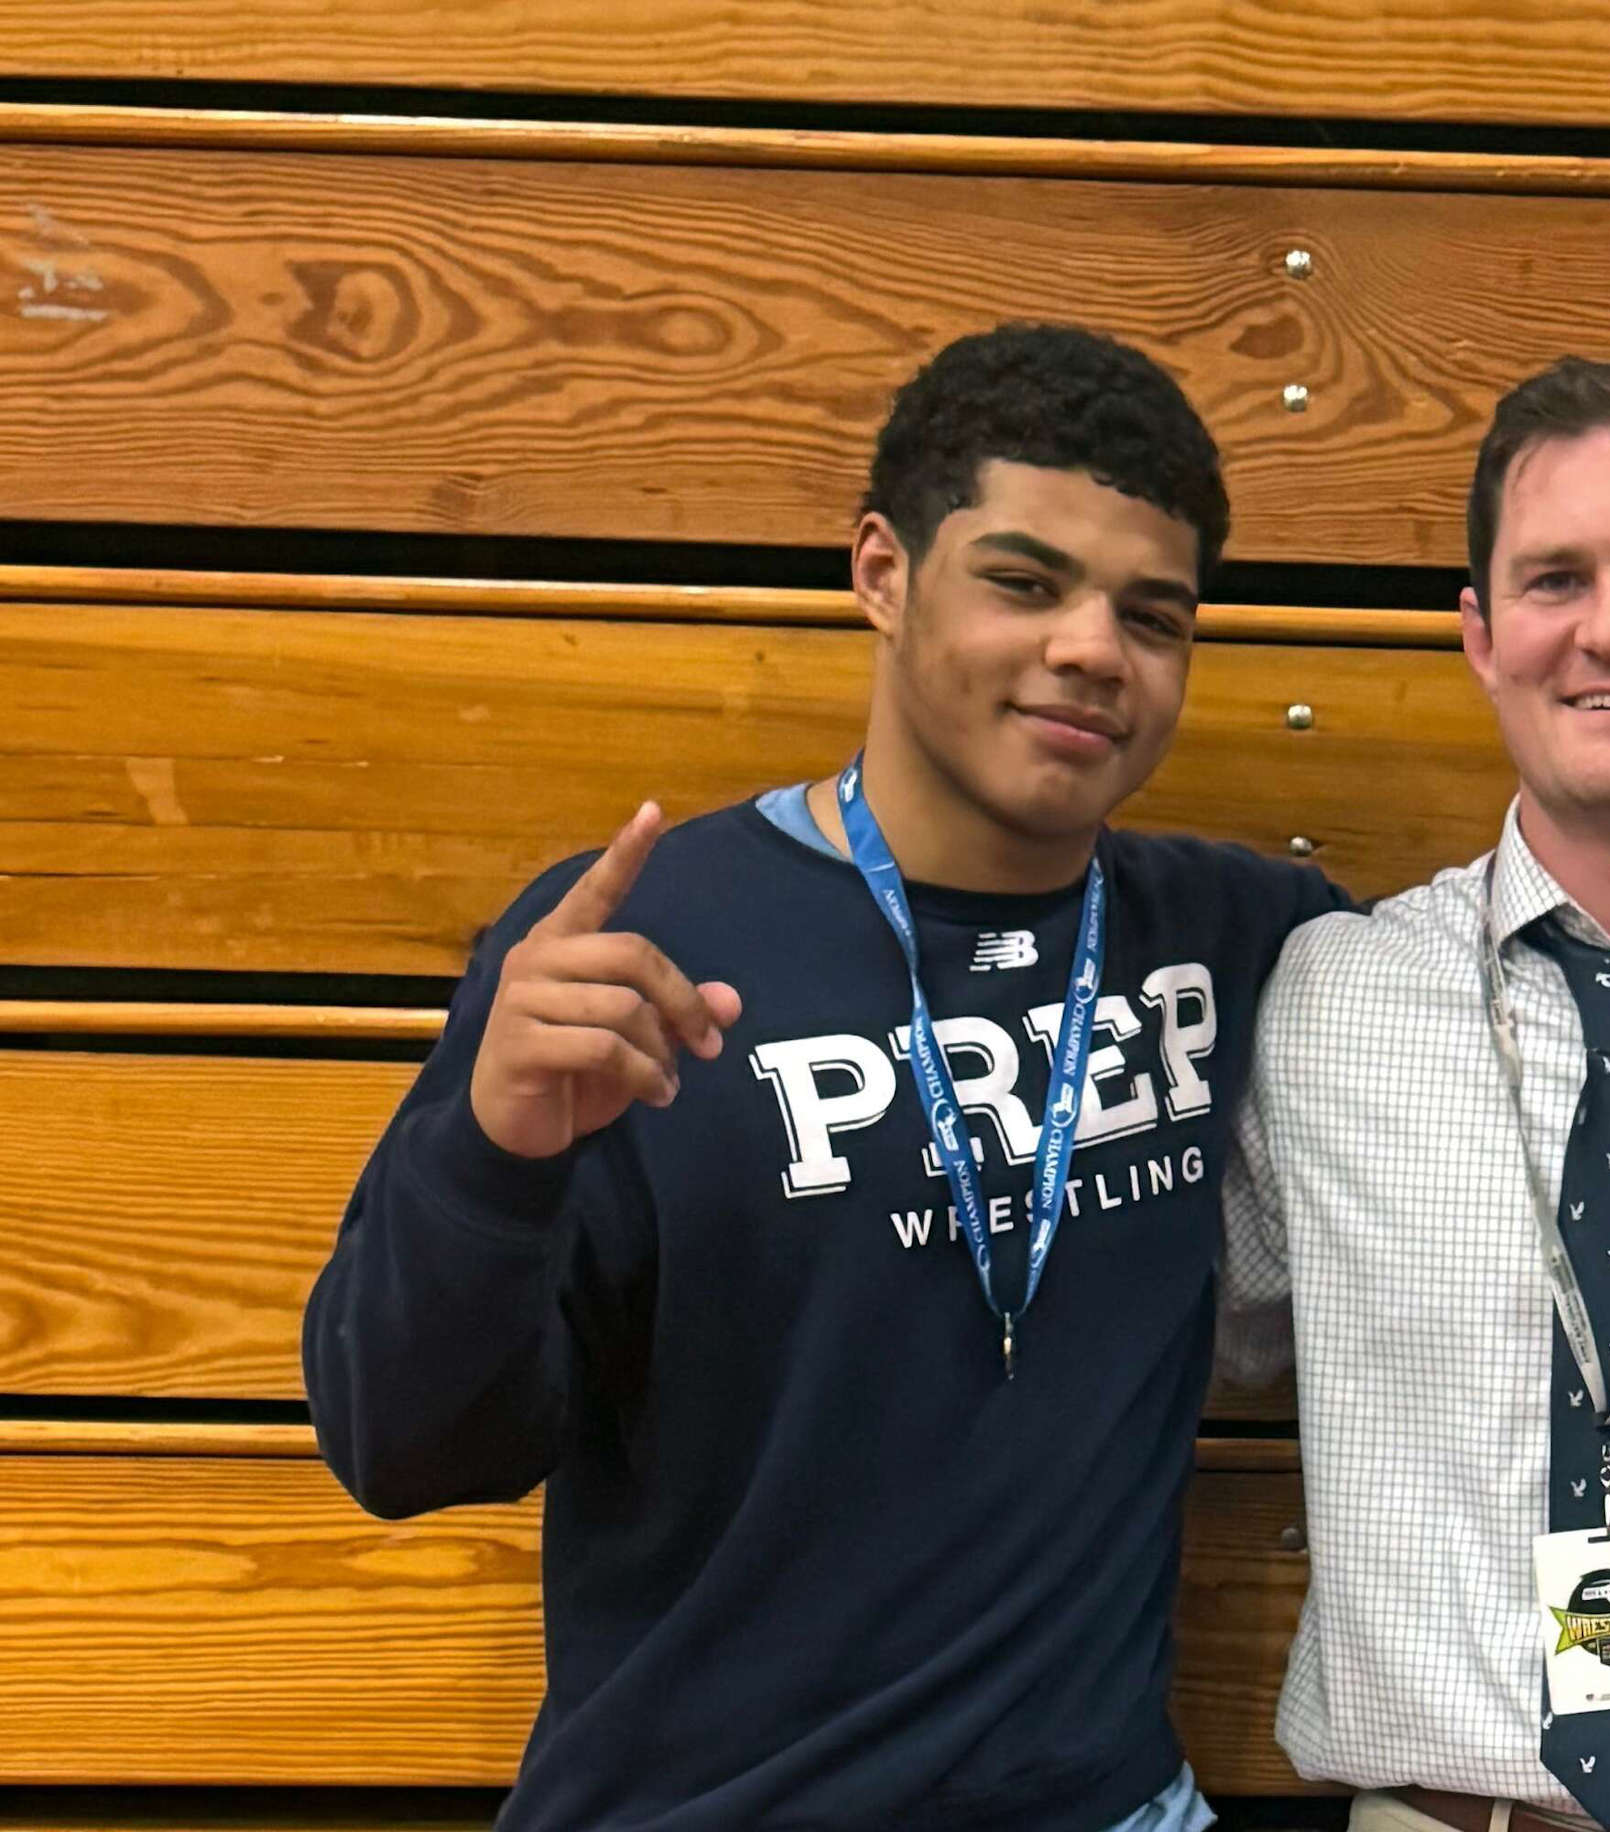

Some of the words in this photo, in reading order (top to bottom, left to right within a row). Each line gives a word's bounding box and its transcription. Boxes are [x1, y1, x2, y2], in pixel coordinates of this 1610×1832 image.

[748, 962, 1218, 1199] PREP
[1063, 1003, 1086, 1078] CHAMPION
[953, 1159, 985, 1243] CHAMPION
[1041, 1129, 1065, 1209] CHAMPION
